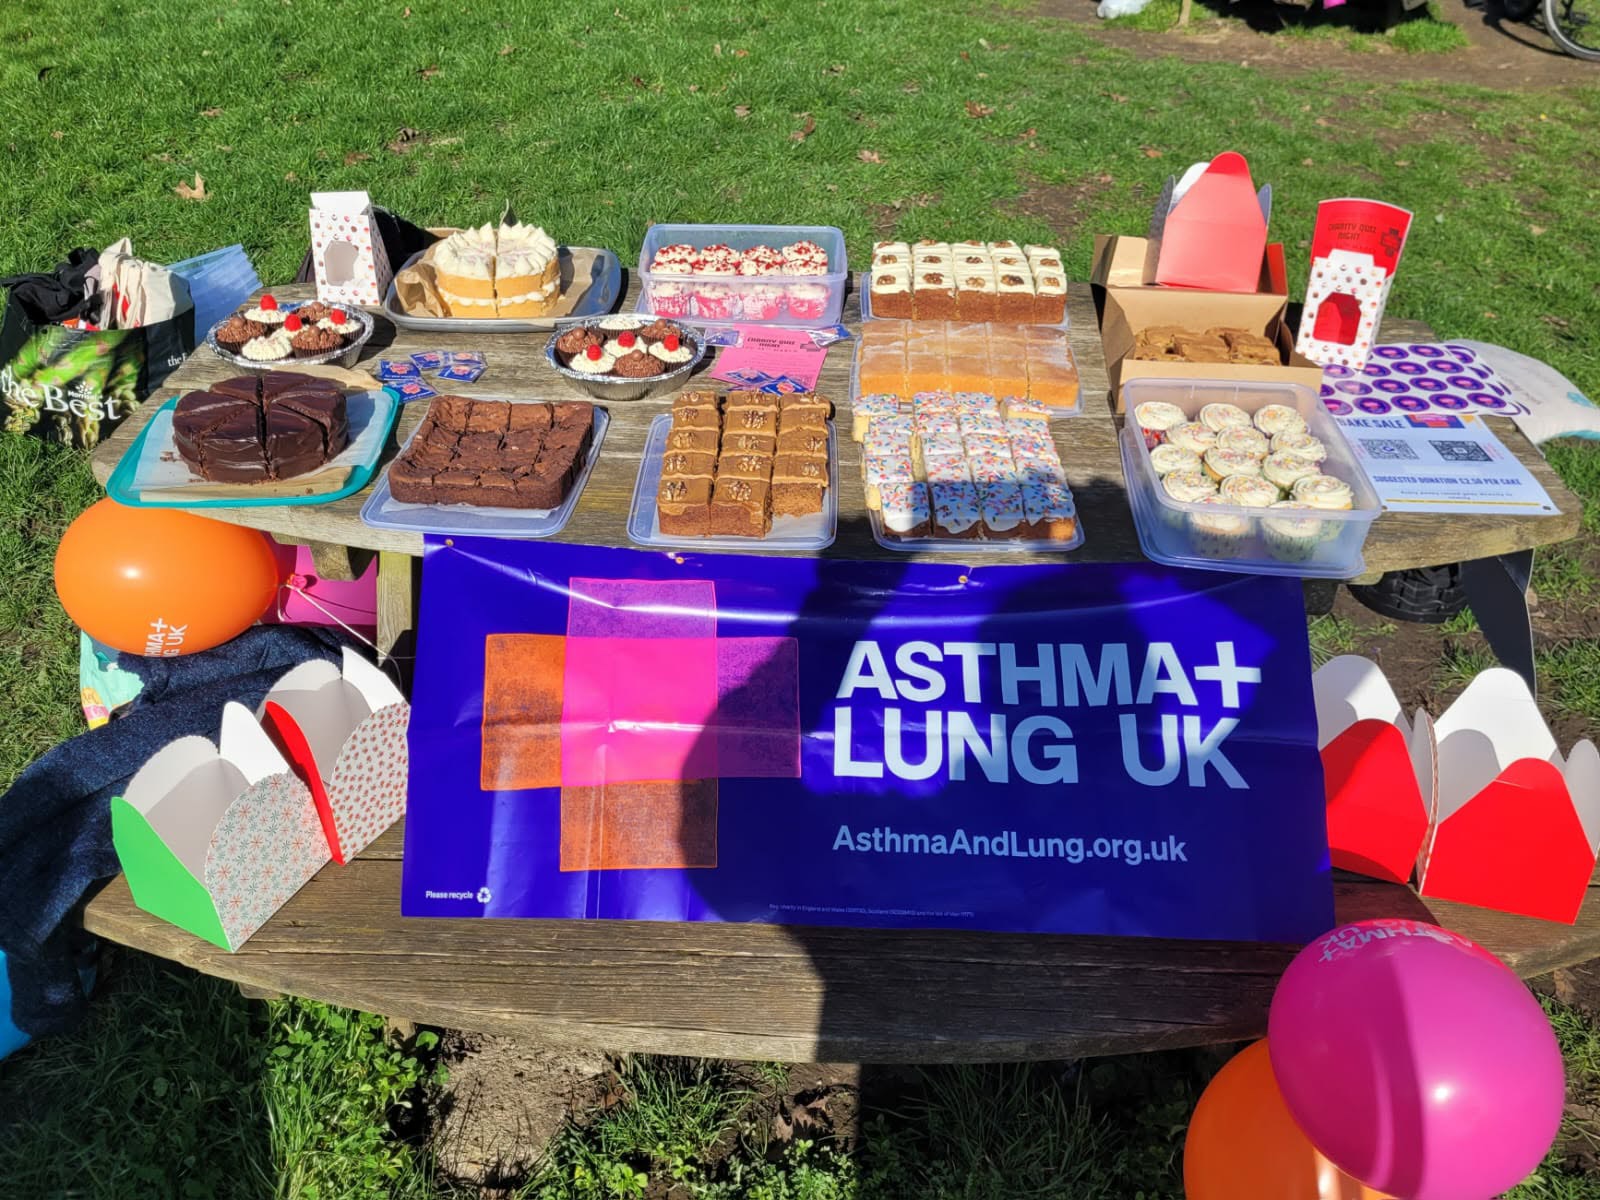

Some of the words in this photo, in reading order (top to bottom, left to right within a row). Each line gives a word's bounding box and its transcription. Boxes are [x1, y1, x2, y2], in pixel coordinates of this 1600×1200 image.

[39, 383, 122, 421] Best
[1372, 419, 1406, 429] SALE
[1372, 475, 1417, 483] SUGGESTED
[1499, 478, 1523, 486] CAKE
[165, 624, 188, 646] UK
[835, 640, 1261, 708] ASTHMA+
[833, 706, 1079, 786] LUNG
[1119, 712, 1250, 790] UK
[832, 825, 1188, 866] AsthmaAndLung.org.uk
[425, 890, 447, 899] Please
[448, 891, 473, 900] recycle
